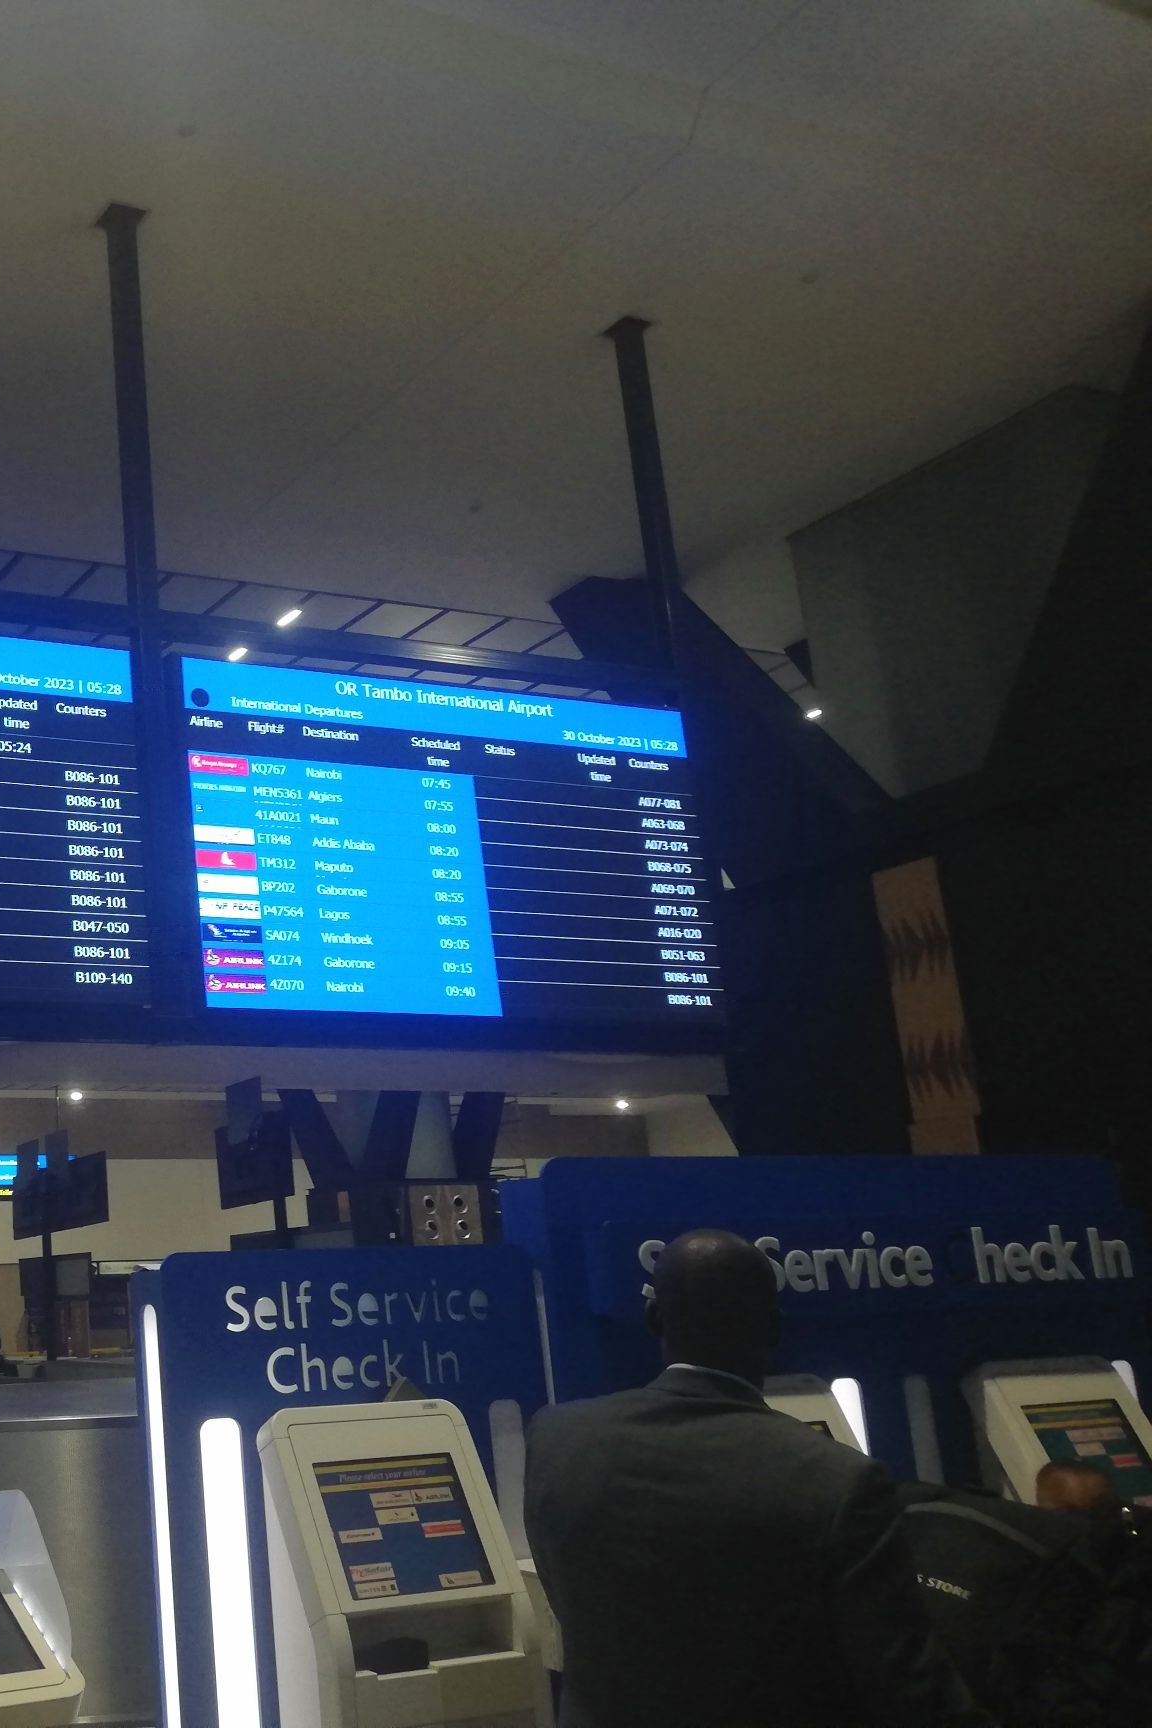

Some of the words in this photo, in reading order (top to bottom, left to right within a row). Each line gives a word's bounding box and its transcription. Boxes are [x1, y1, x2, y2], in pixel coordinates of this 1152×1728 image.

[44, 677, 74, 690] 2023
[87, 680, 123, 695] 05:28
[335, 681, 358, 696] OR
[361, 684, 412, 702] Tambo
[416, 690, 504, 712] International
[508, 700, 554, 717] Airport
[56, 703, 107, 718] Counters
[230, 696, 301, 713] International
[304, 704, 364, 719] Departures
[3, 717, 30, 729] time
[189, 715, 223, 728] Airline
[248, 720, 285, 735] Flight#
[302, 726, 359, 742] Destination
[409, 737, 461, 751] Scheduled
[483, 744, 516, 756] Status
[577, 753, 616, 766] Updated
[628, 758, 669, 771] Counters
[562, 730, 576, 740] 30
[576, 732, 616, 744] October
[617, 736, 641, 747] 2023
[650, 740, 678, 751] 05:28
[426, 756, 450, 767] time
[65, 770, 120, 786] B086-101
[252, 764, 285, 775] KQ767
[306, 767, 342, 780] Nairobi
[422, 778, 451, 789] 07:45
[589, 771, 612, 782] time
[65, 794, 122, 810] B086-101
[308, 790, 344, 803] Algiers
[310, 814, 340, 825] Maun
[66, 820, 123, 836] B086-101
[256, 833, 292, 845] ET848
[312, 837, 341, 848] Addis
[343, 839, 375, 853] Ababa
[68, 844, 125, 859] B086-101
[259, 857, 296, 869] TM312
[314, 860, 354, 873] Maputo
[70, 868, 126, 884] B086-101
[261, 881, 296, 893] BP202
[315, 884, 367, 897] Gaborone
[70, 895, 128, 909] B086-101
[319, 908, 351, 921] Lagos
[72, 920, 129, 934] B047-050
[265, 930, 300, 941] SA074
[321, 933, 374, 945] Windhoek
[74, 945, 131, 959] B086-101
[267, 955, 303, 966] 4Z174
[323, 957, 375, 970] Gaborone
[76, 970, 133, 984] B109-140
[270, 980, 304, 991] 4Z070
[326, 981, 364, 992] Nairobi
[969, 1224, 1086, 1285] heck
[1086, 1226, 1134, 1279] In
[225, 1280, 311, 1332] Self
[330, 1279, 489, 1328] Service
[267, 1338, 408, 1394] Check
[422, 1340, 460, 1384] In
